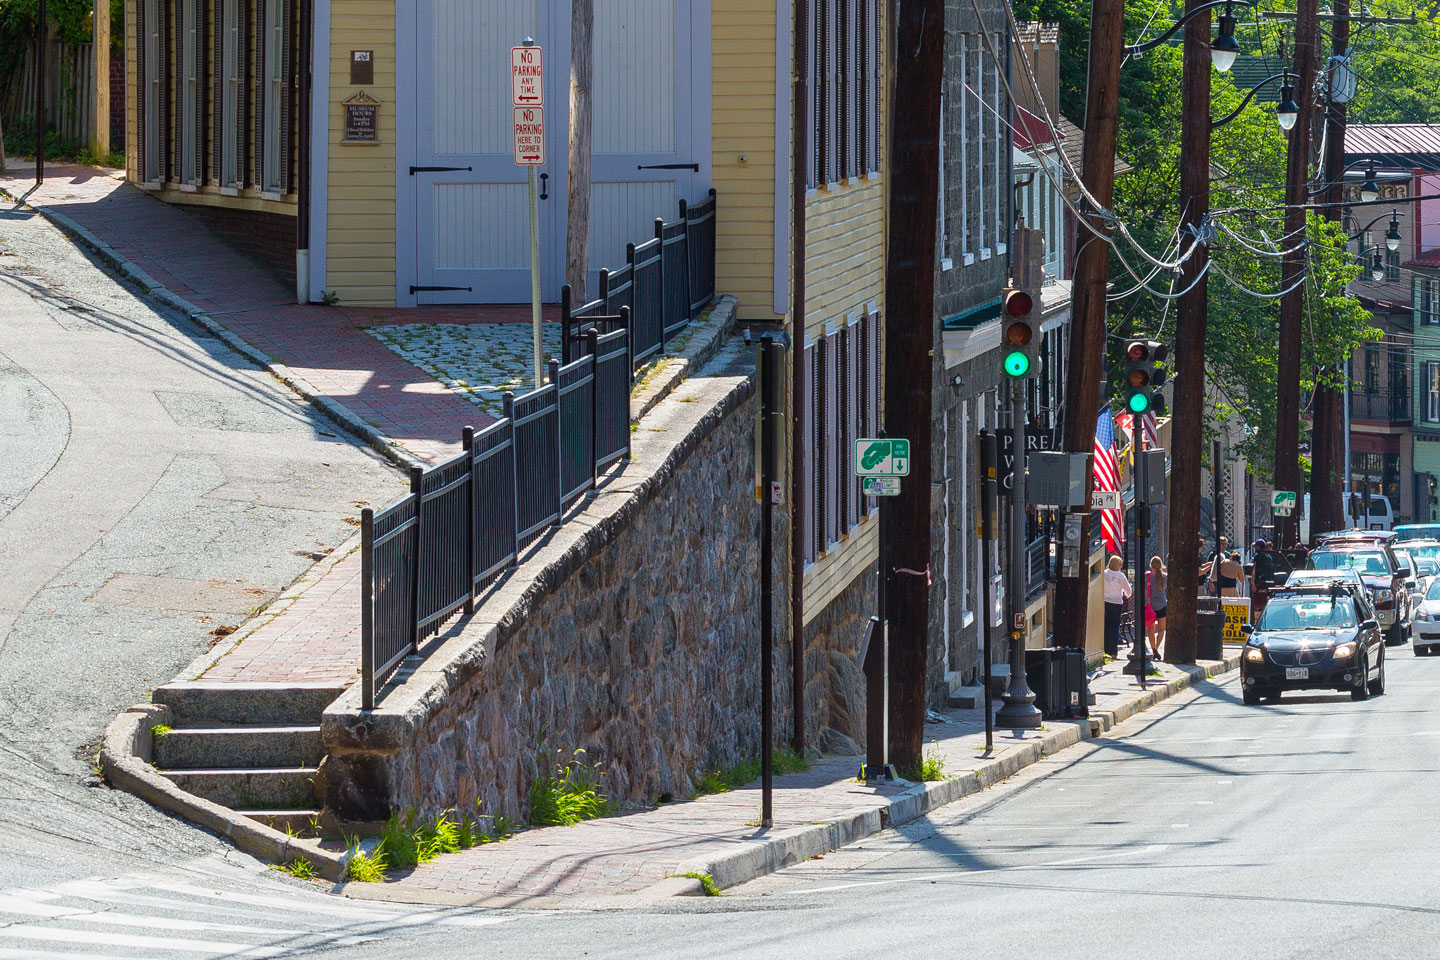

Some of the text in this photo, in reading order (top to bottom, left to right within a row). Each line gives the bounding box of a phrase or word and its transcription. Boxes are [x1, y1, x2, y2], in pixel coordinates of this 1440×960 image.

[520, 52, 533, 64] NO
[513, 66, 541, 76] PARKING
[521, 77, 534, 85] ANY
[520, 86, 536, 94] TIME
[522, 110, 534, 122] NO
[515, 124, 542, 134] PARKING
[517, 136, 541, 144] HERE TO
[518, 145, 540, 153] CORNER
[1003, 435, 1049, 450] PRE
[1105, 494, 1114, 502] PK
[1225, 616, 1247, 624] ASH
[1223, 630, 1245, 638] OLD
